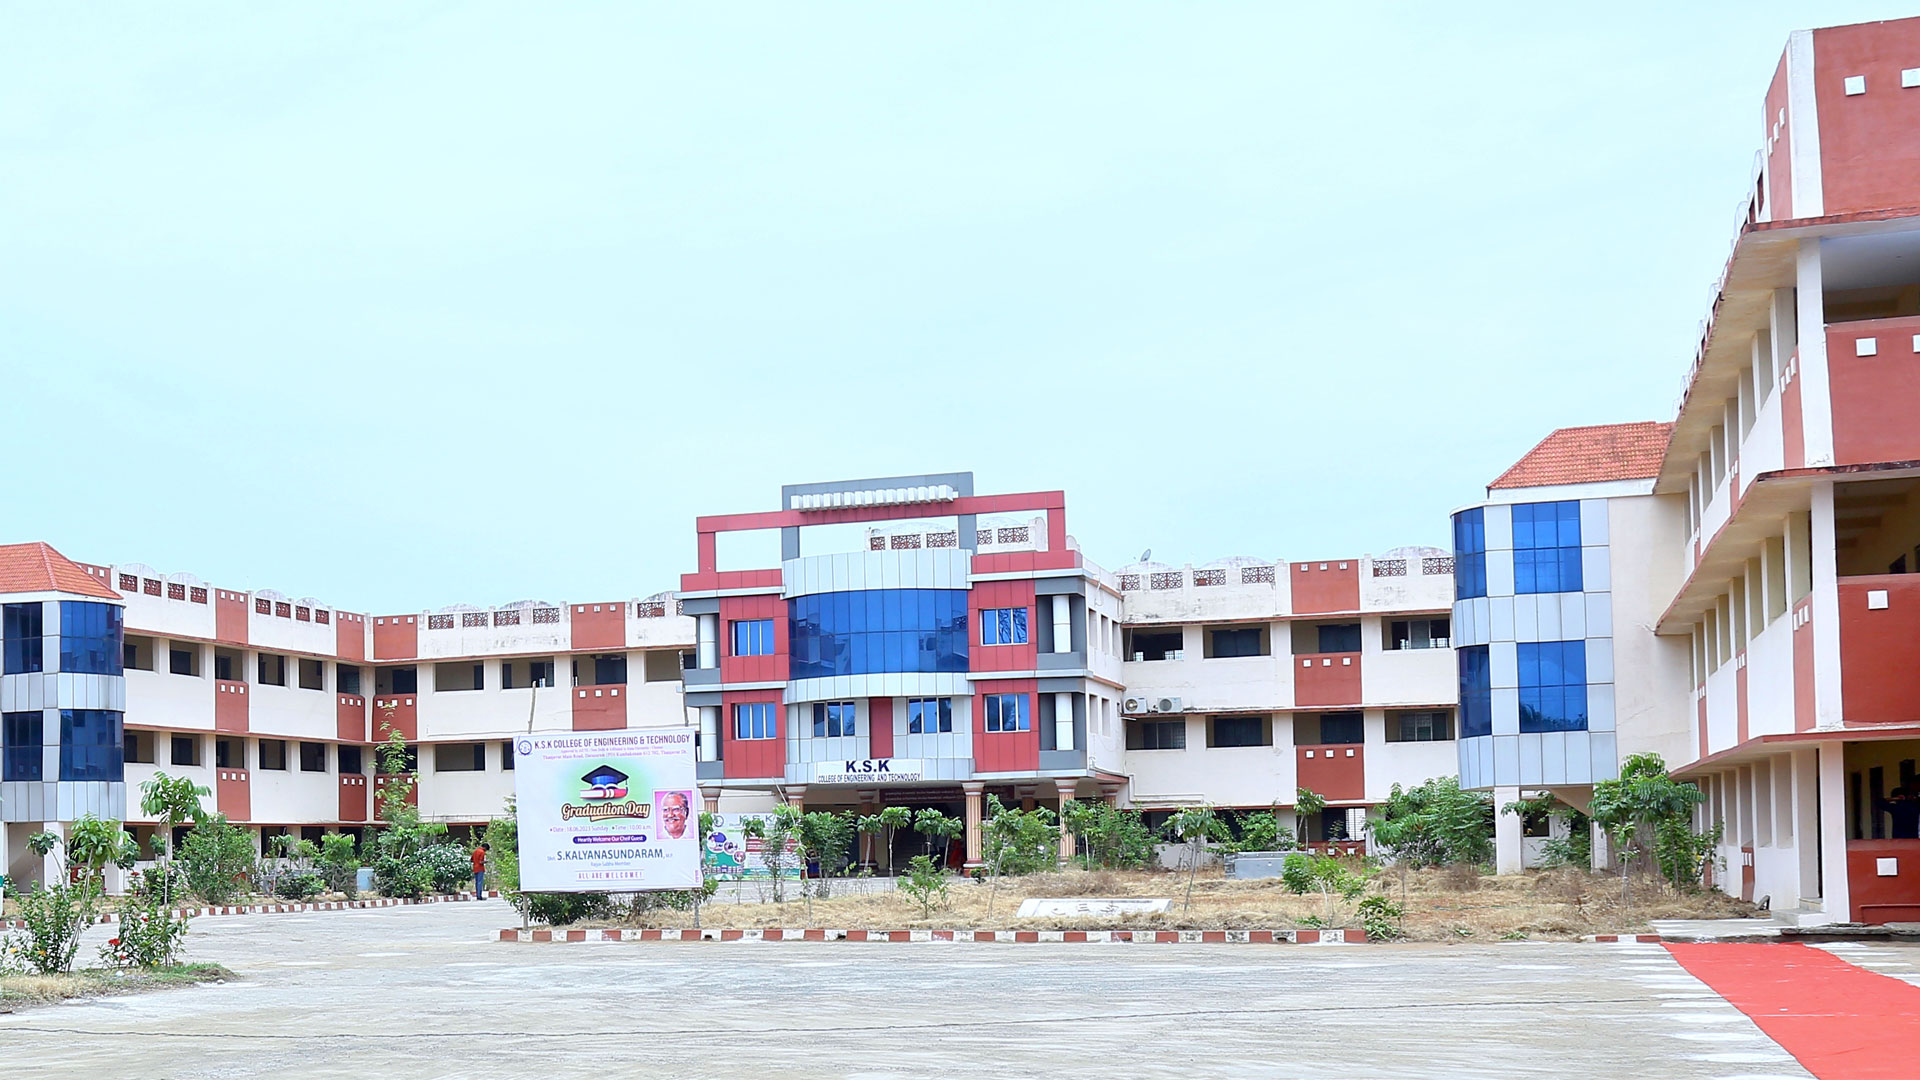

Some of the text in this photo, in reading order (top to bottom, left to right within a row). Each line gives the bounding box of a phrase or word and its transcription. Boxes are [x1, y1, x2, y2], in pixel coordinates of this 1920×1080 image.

[535, 740, 552, 750] K.S.K
[553, 738, 582, 749] COLLEGE
[584, 738, 592, 747] OF
[594, 736, 638, 747] ENGINEERING
[640, 736, 645, 745] &
[646, 734, 690, 745] TECHNOLOGY
[846, 760, 890, 773] K.S.K
[818, 773, 920, 783] COLLEGE OF ENGINEERING AND TECHNOLOGY
[562, 800, 650, 821] Graduation Day
[606, 871, 642, 879] WELCOME!
